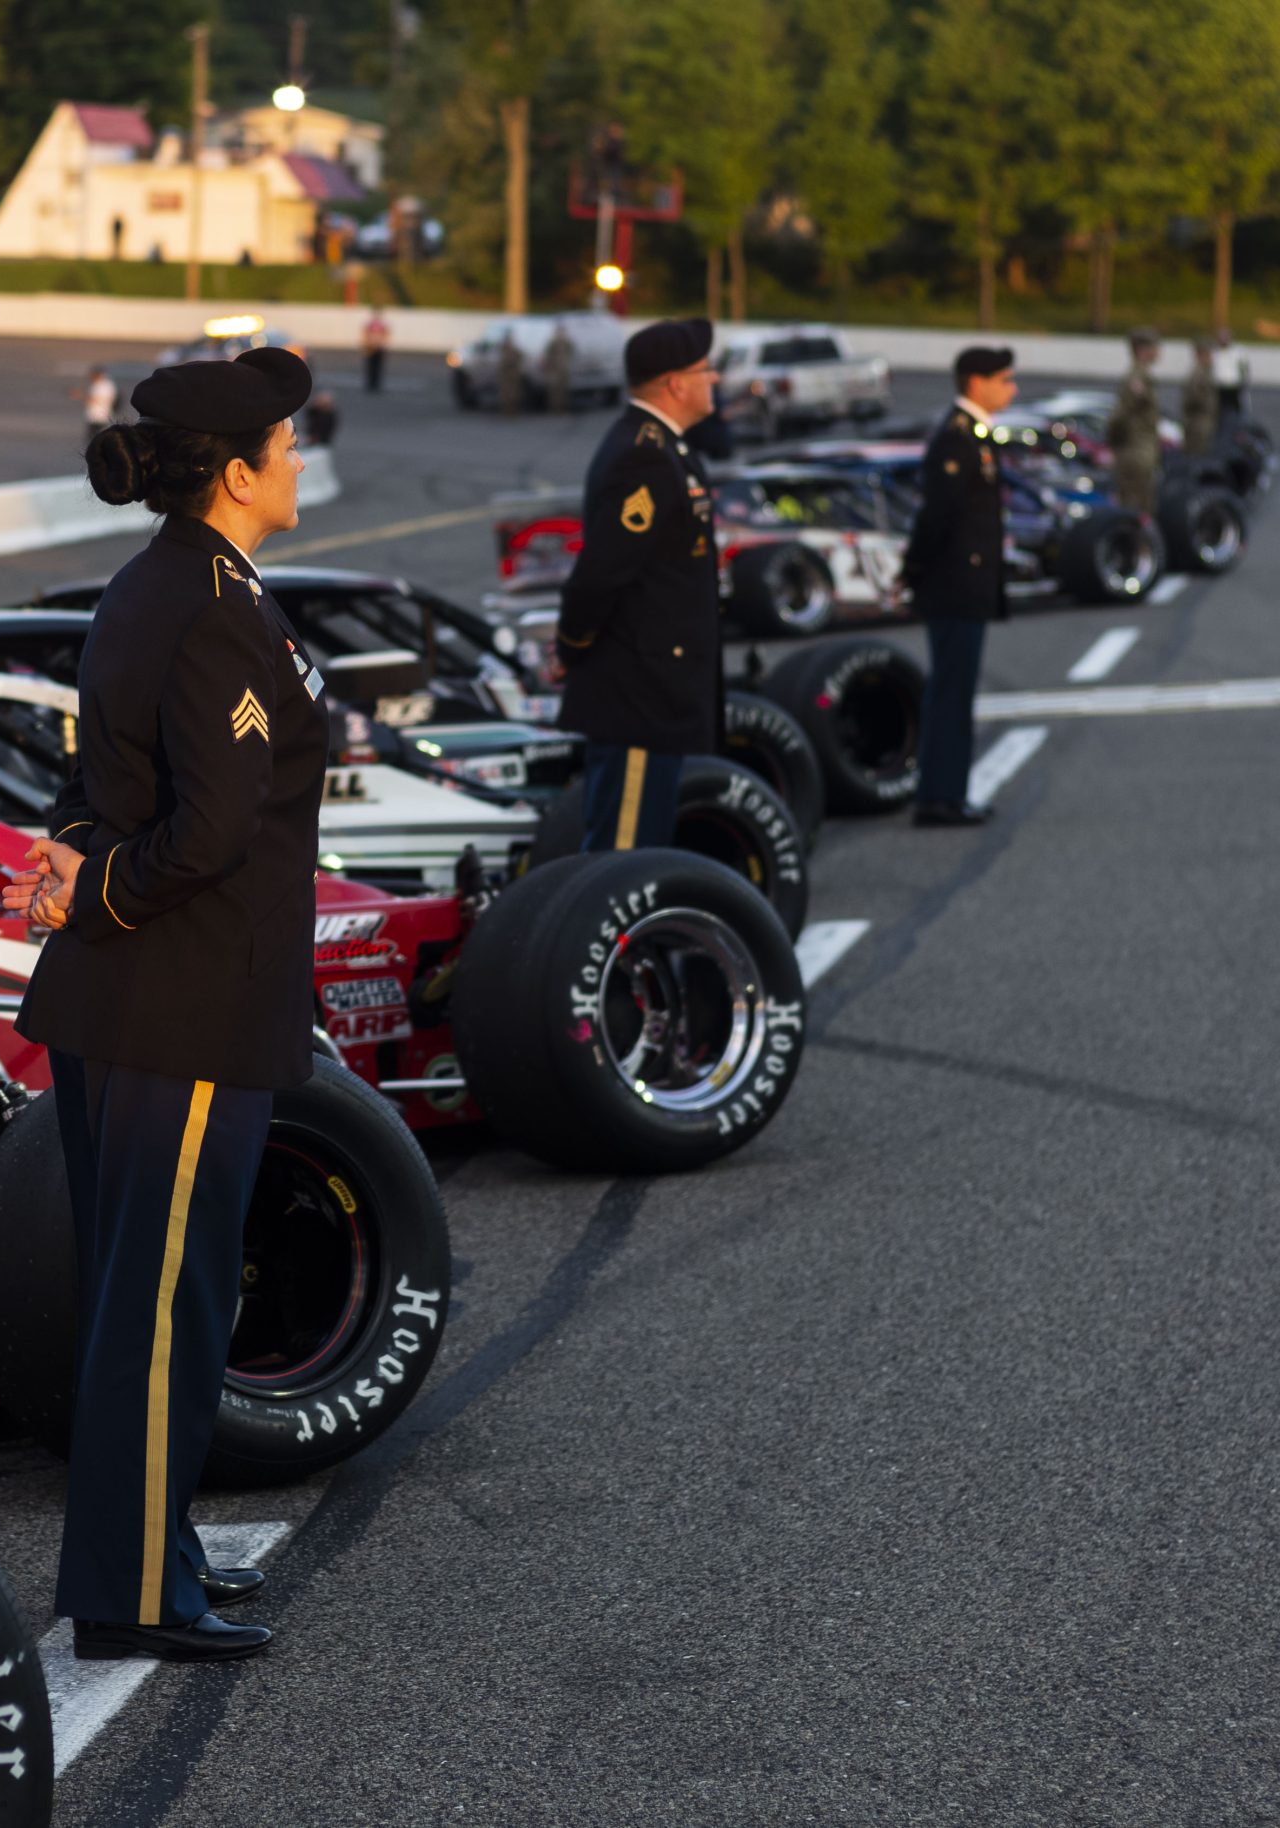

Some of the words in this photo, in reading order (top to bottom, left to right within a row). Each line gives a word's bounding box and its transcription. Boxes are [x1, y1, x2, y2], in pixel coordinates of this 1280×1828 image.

[570, 882, 658, 1022] Hoosier
[328, 1009, 412, 1040] ARP
[717, 996, 802, 1135] Hoosier
[297, 1274, 441, 1442] Hoosier
